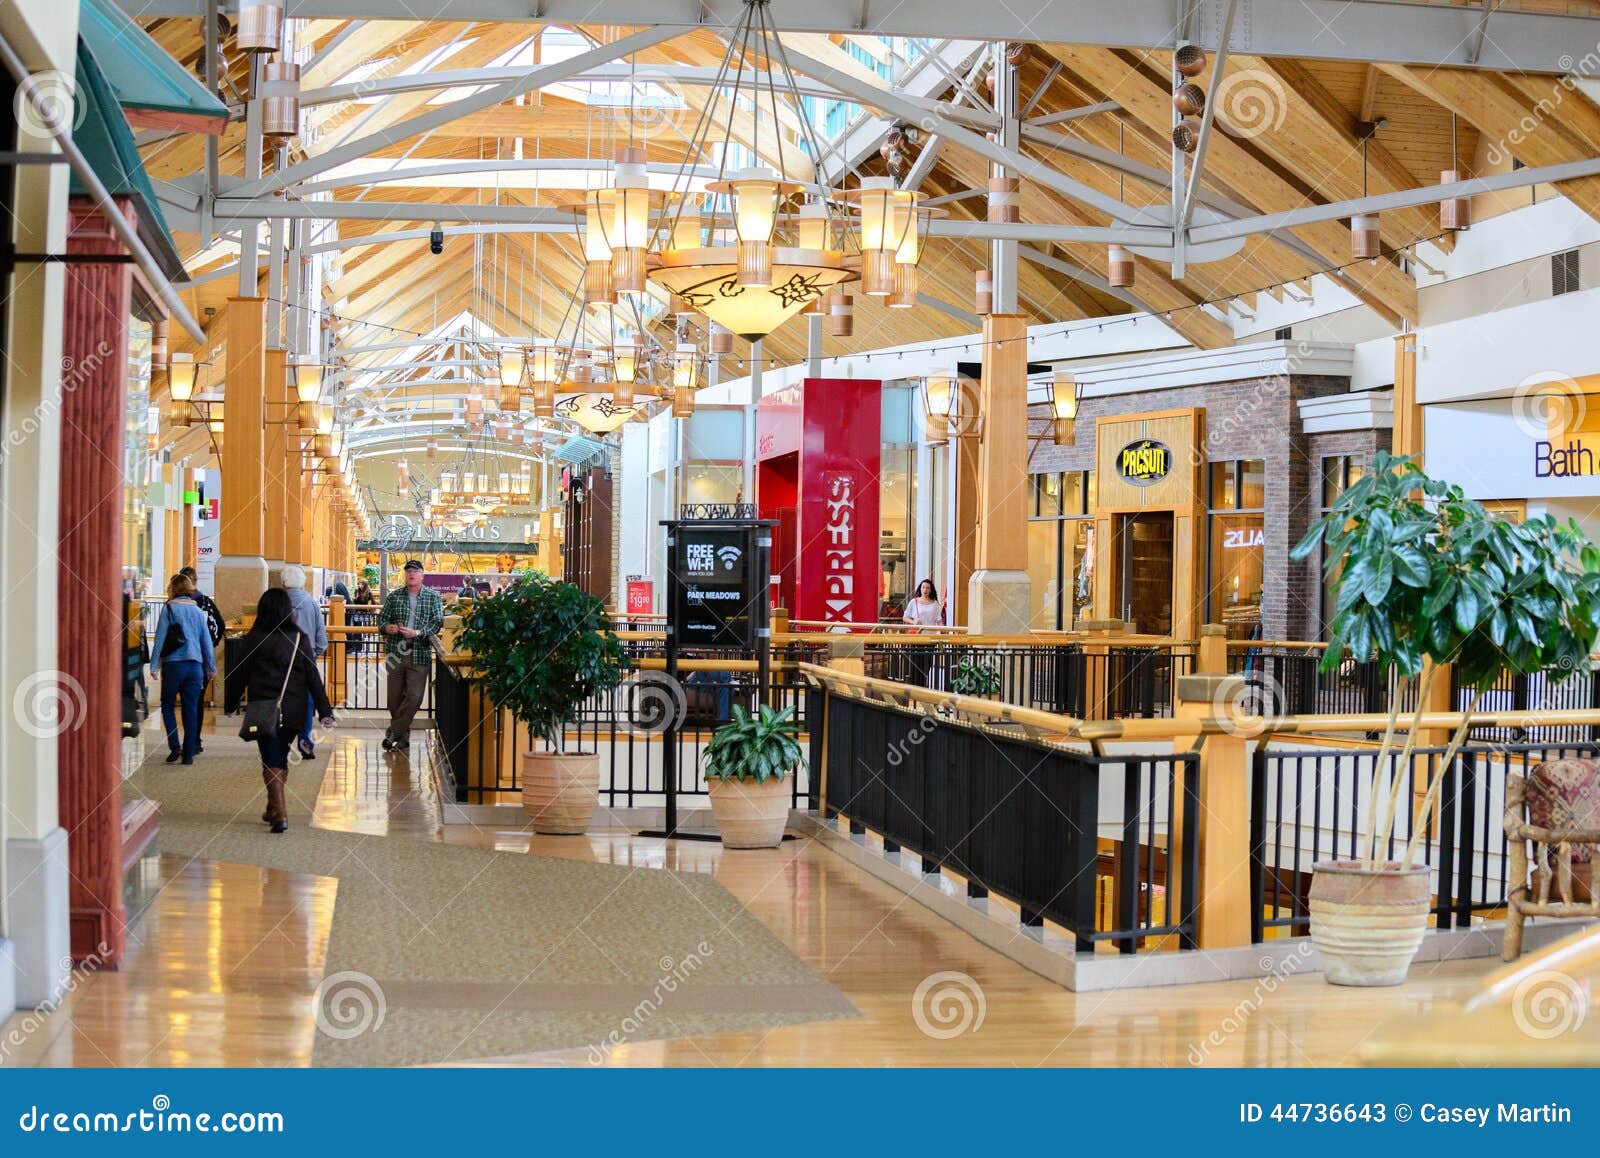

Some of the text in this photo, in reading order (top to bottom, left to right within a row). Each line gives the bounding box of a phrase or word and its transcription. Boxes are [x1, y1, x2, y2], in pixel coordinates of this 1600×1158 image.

[1535, 439, 1593, 477] Bath
[388, 513, 500, 539] Dird's
[686, 544, 714, 558] FREE
[825, 476, 855, 634] XPRESS
[687, 591, 740, 600] PARK MEADOWS
